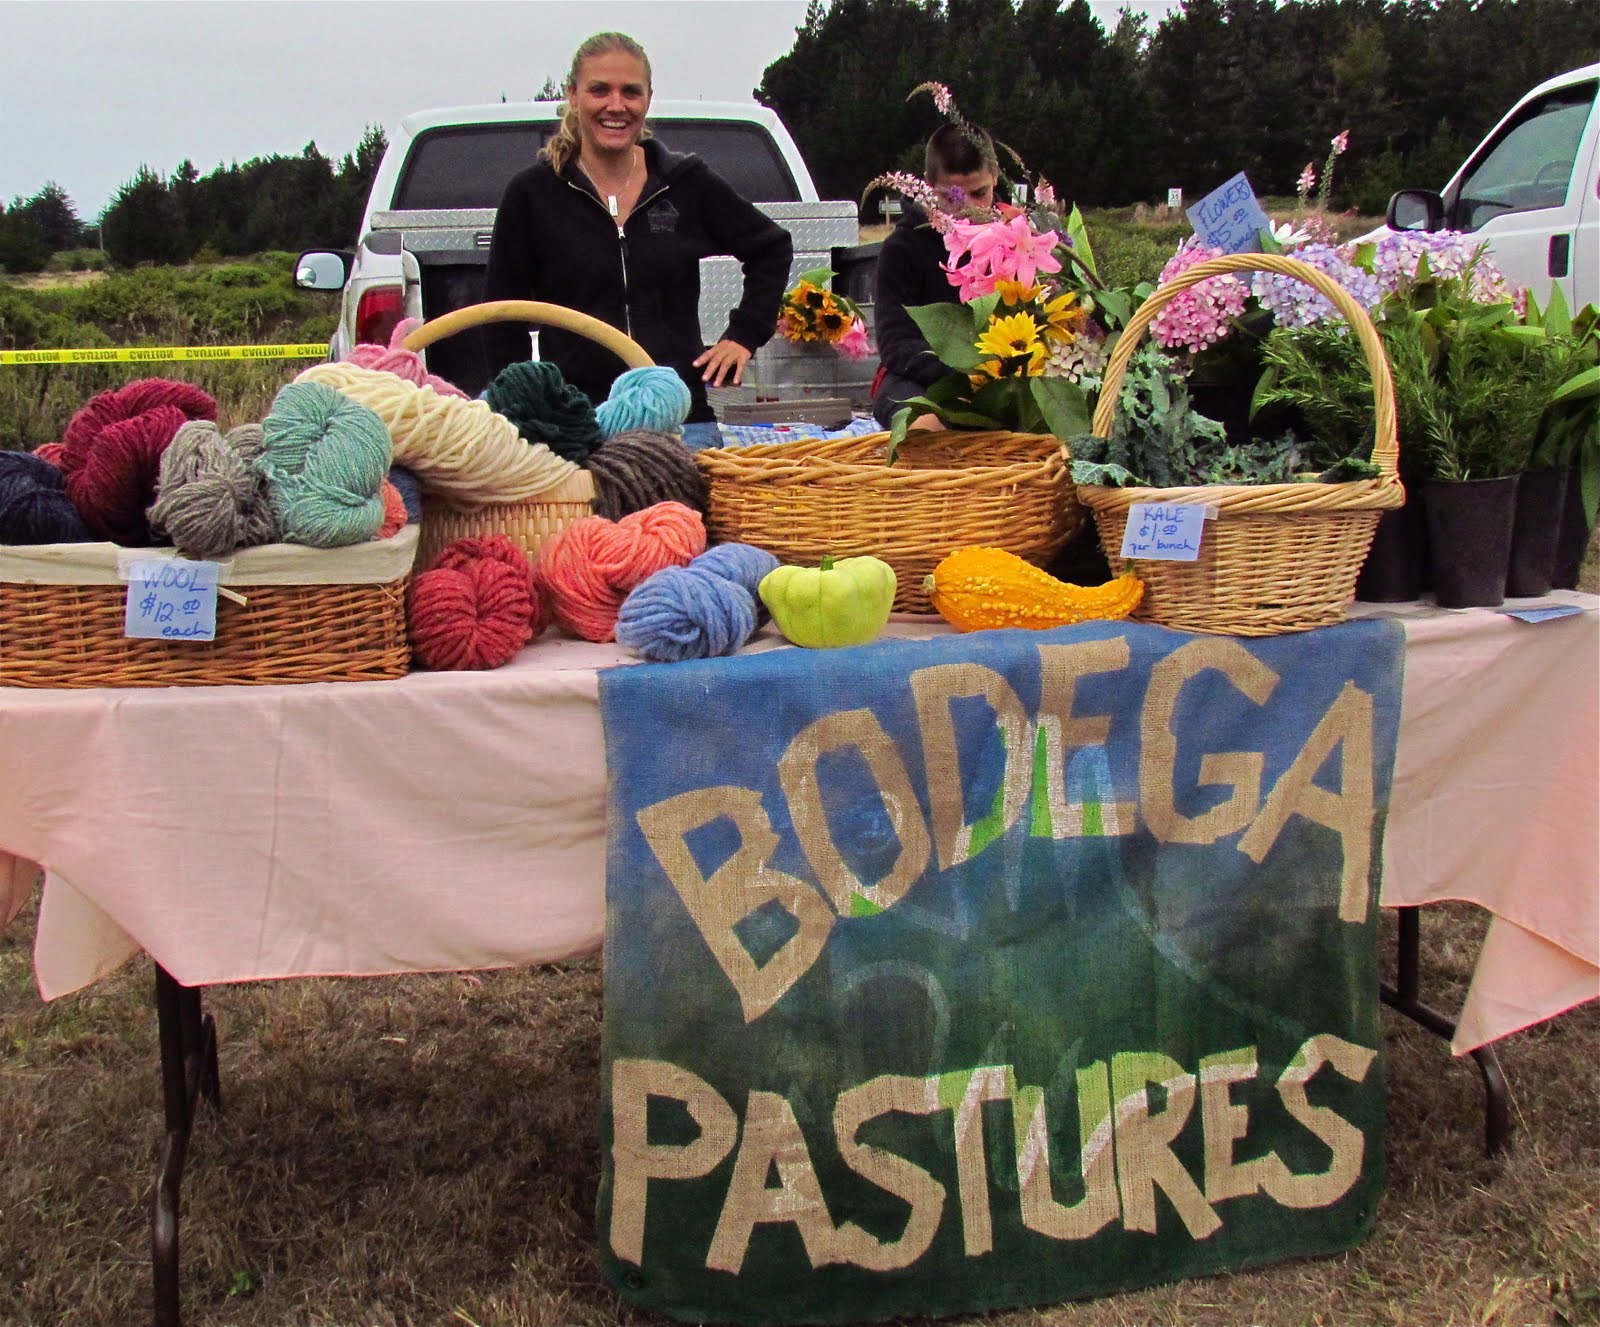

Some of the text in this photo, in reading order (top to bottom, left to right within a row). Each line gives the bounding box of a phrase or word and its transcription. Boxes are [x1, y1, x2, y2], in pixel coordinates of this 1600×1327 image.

[1144, 507, 1189, 523] KALE
[1129, 539, 1196, 554] per bunch
[142, 563, 208, 592] WOOL
[162, 621, 211, 637] each
[636, 635, 1377, 1024] BODEGA
[610, 1033, 1378, 1276] PASTURES
